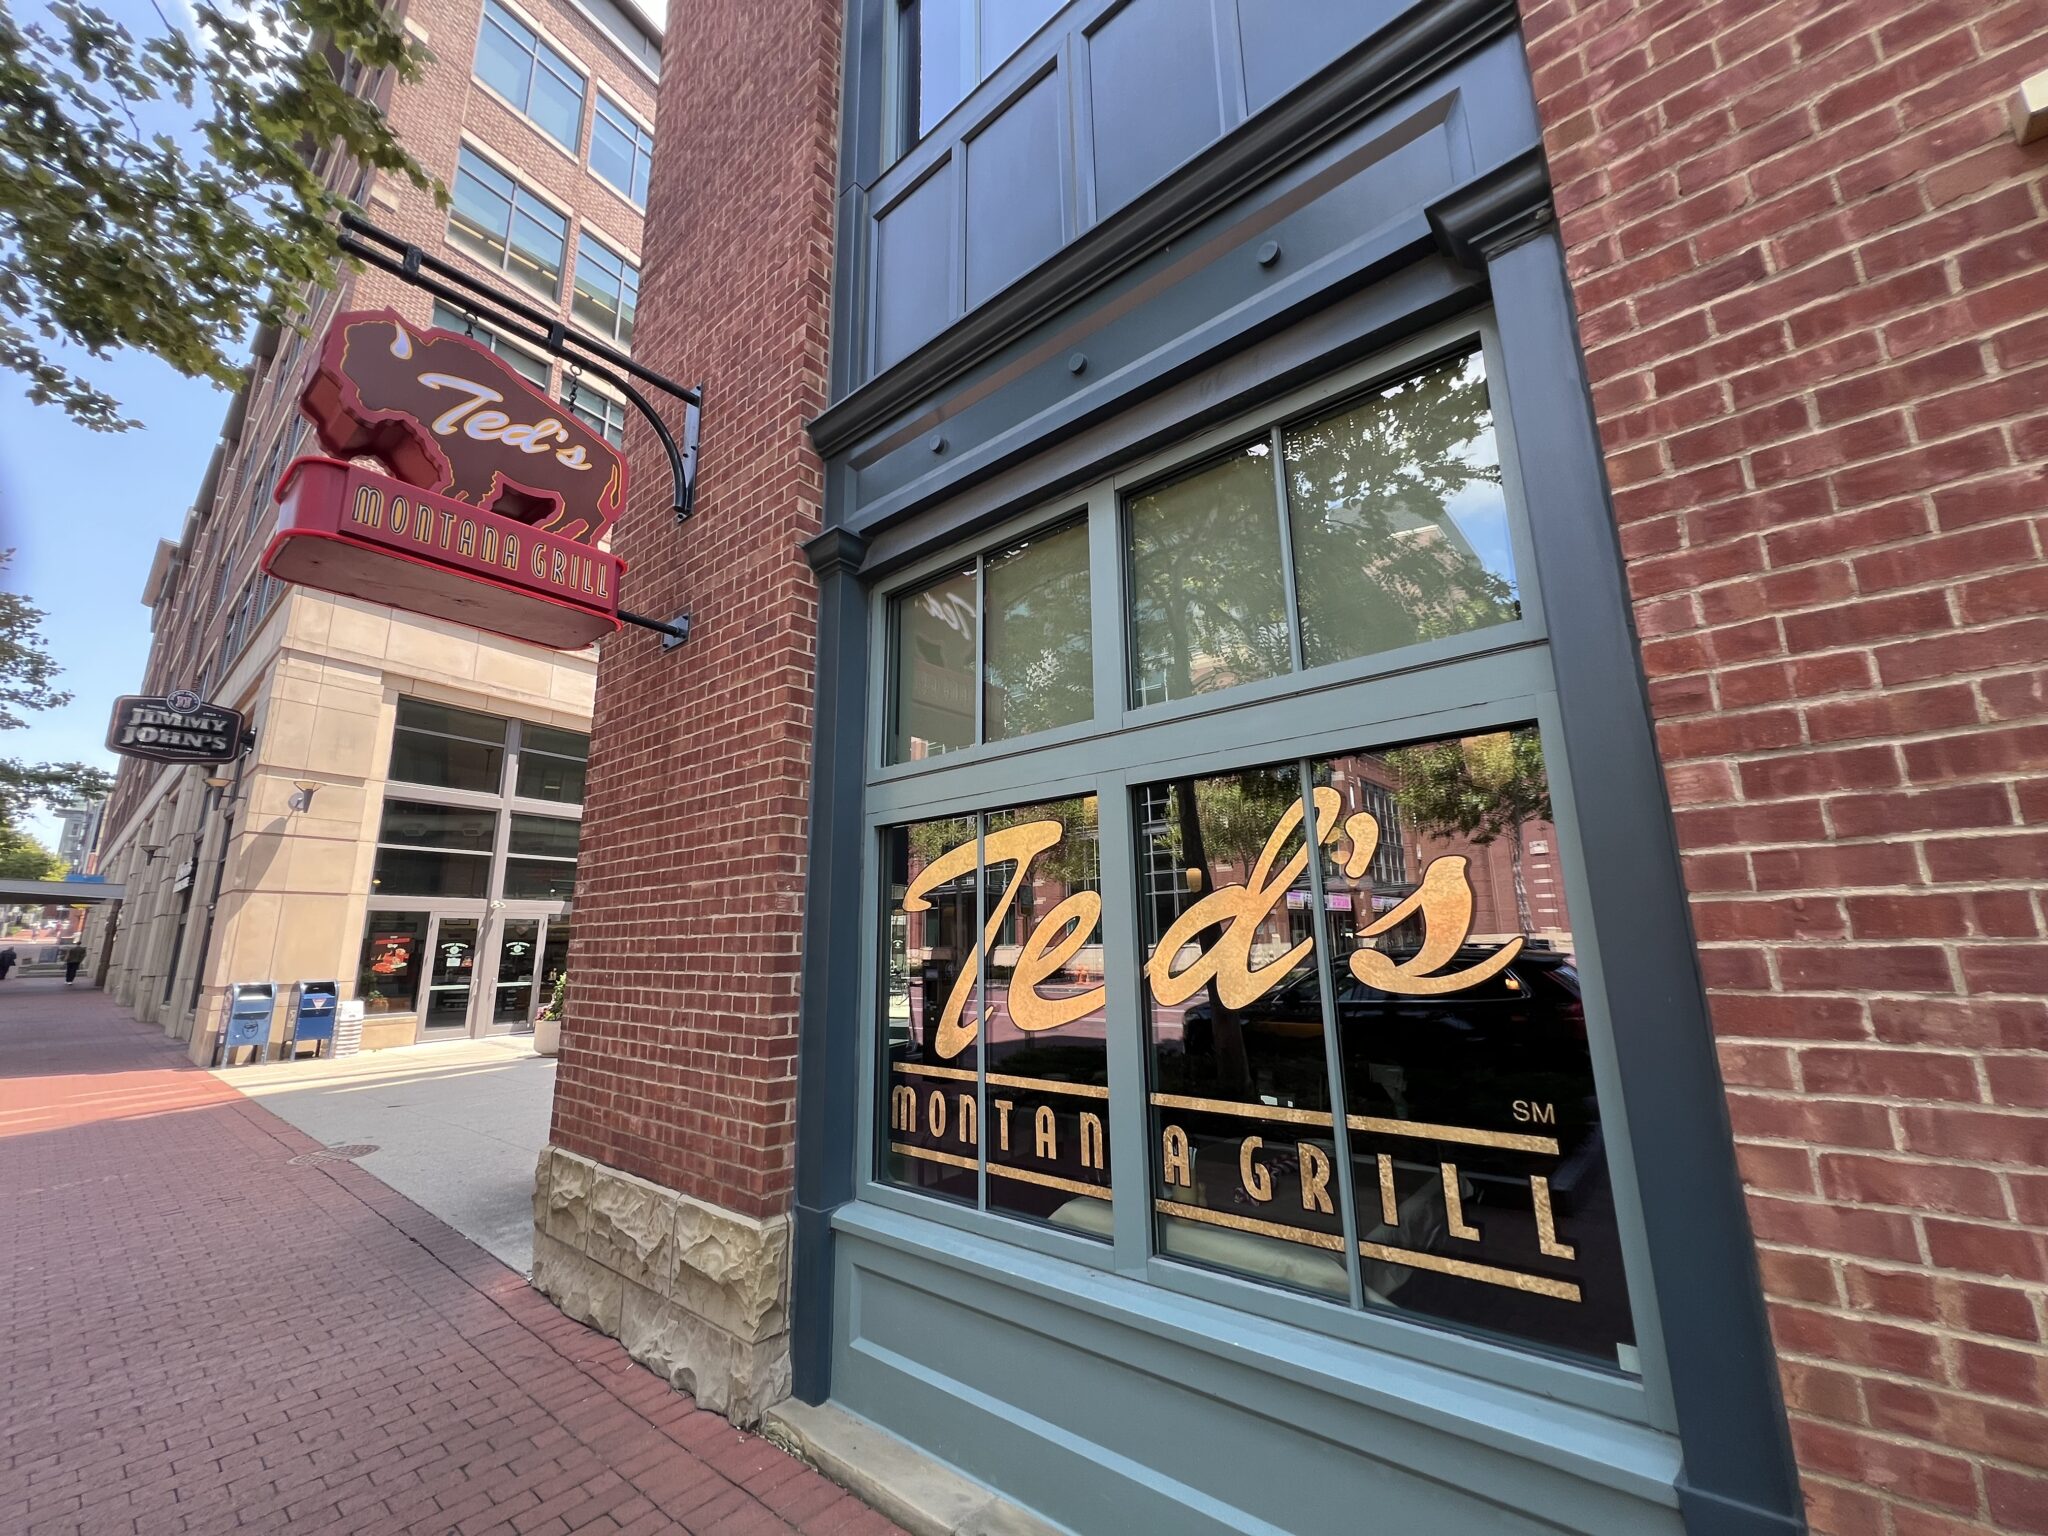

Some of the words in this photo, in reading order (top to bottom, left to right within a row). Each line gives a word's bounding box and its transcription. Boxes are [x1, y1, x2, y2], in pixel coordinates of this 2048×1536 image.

[417, 373, 593, 471] Ted's
[351, 484, 520, 571] MONTANA
[531, 542, 608, 599] GRILL
[120, 726, 227, 750] JOHN'S
[128, 707, 228, 732] JIMMY
[903, 786, 1525, 1060] Ted's
[1512, 1099, 1557, 1126] SM
[890, 1084, 1192, 1187] MONTANA
[1239, 1135, 1576, 1261] GRILL
